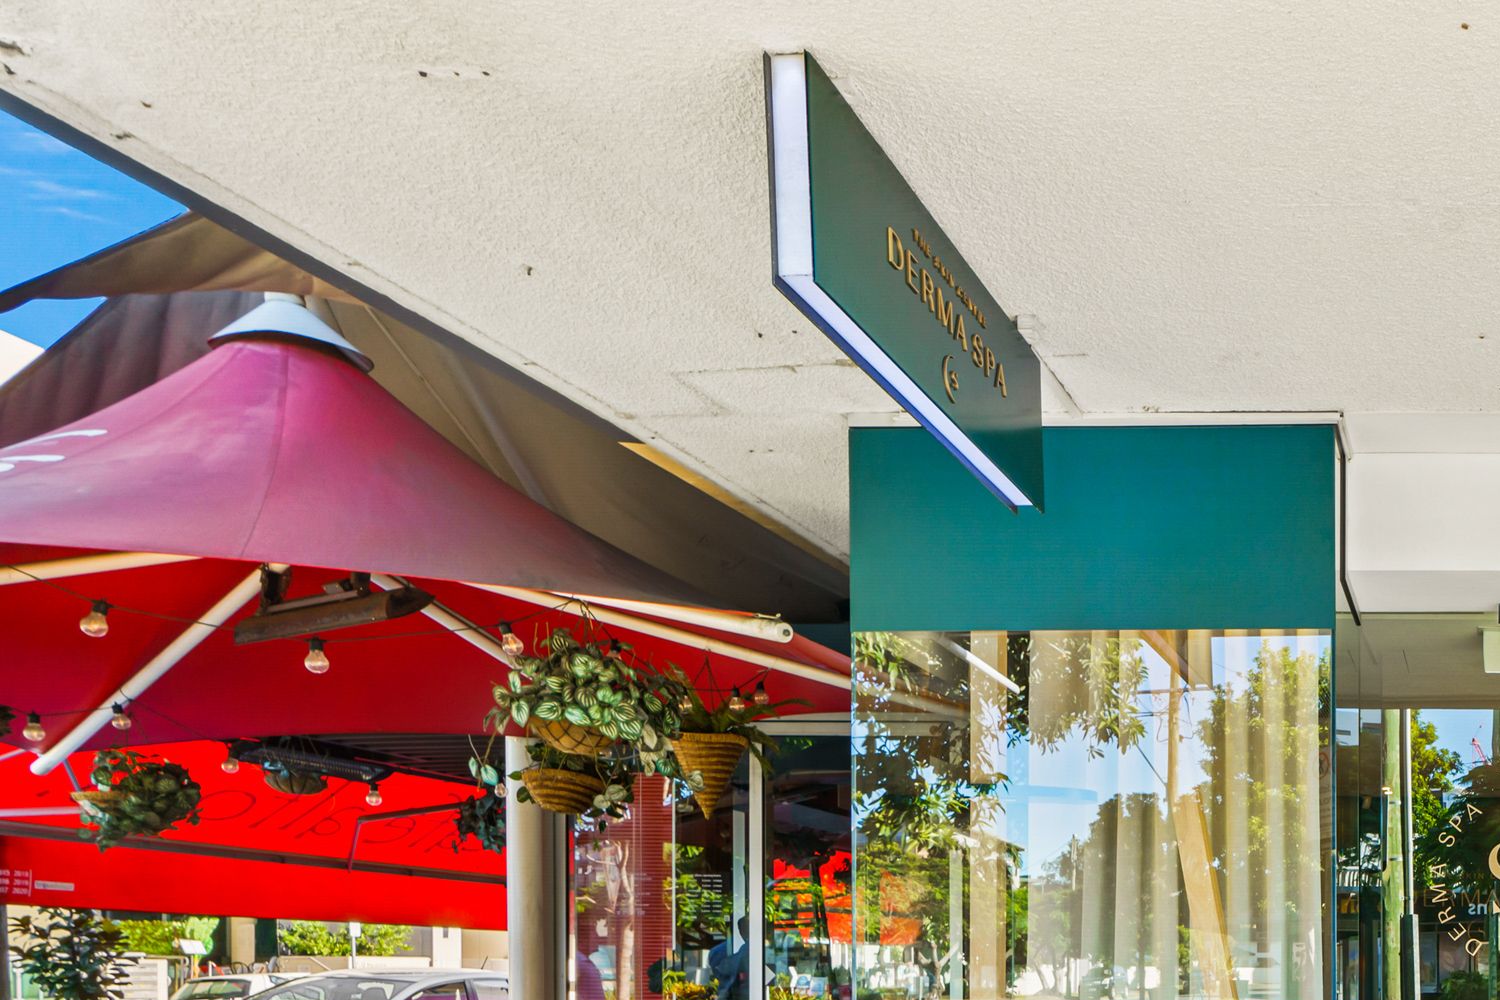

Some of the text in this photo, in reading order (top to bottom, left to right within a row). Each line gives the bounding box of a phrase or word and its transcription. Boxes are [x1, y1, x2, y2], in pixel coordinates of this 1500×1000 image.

[887, 225, 1007, 399] DERMA SPA
[1438, 802, 1483, 848] SPA
[1430, 863, 1489, 957] DERMA
